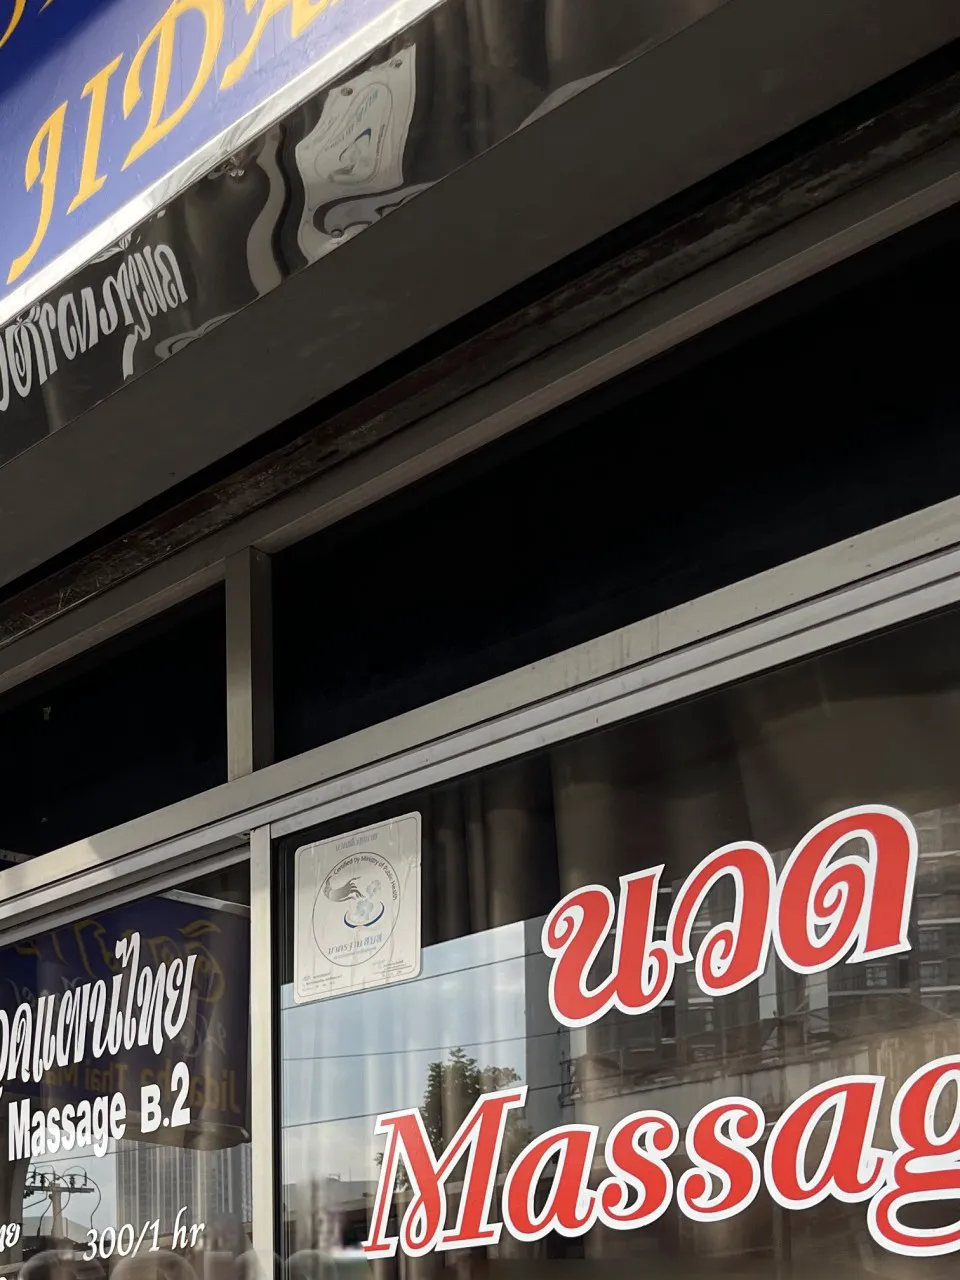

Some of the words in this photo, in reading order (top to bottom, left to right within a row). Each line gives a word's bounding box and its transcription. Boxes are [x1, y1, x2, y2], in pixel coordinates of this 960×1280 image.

[541, 804, 918, 1028] นวด
[8, 1091, 127, 1157] Massage
[140, 1061, 191, 1134] B.2
[82, 1218, 161, 1262] 300/1
[171, 1206, 206, 1250] hr
